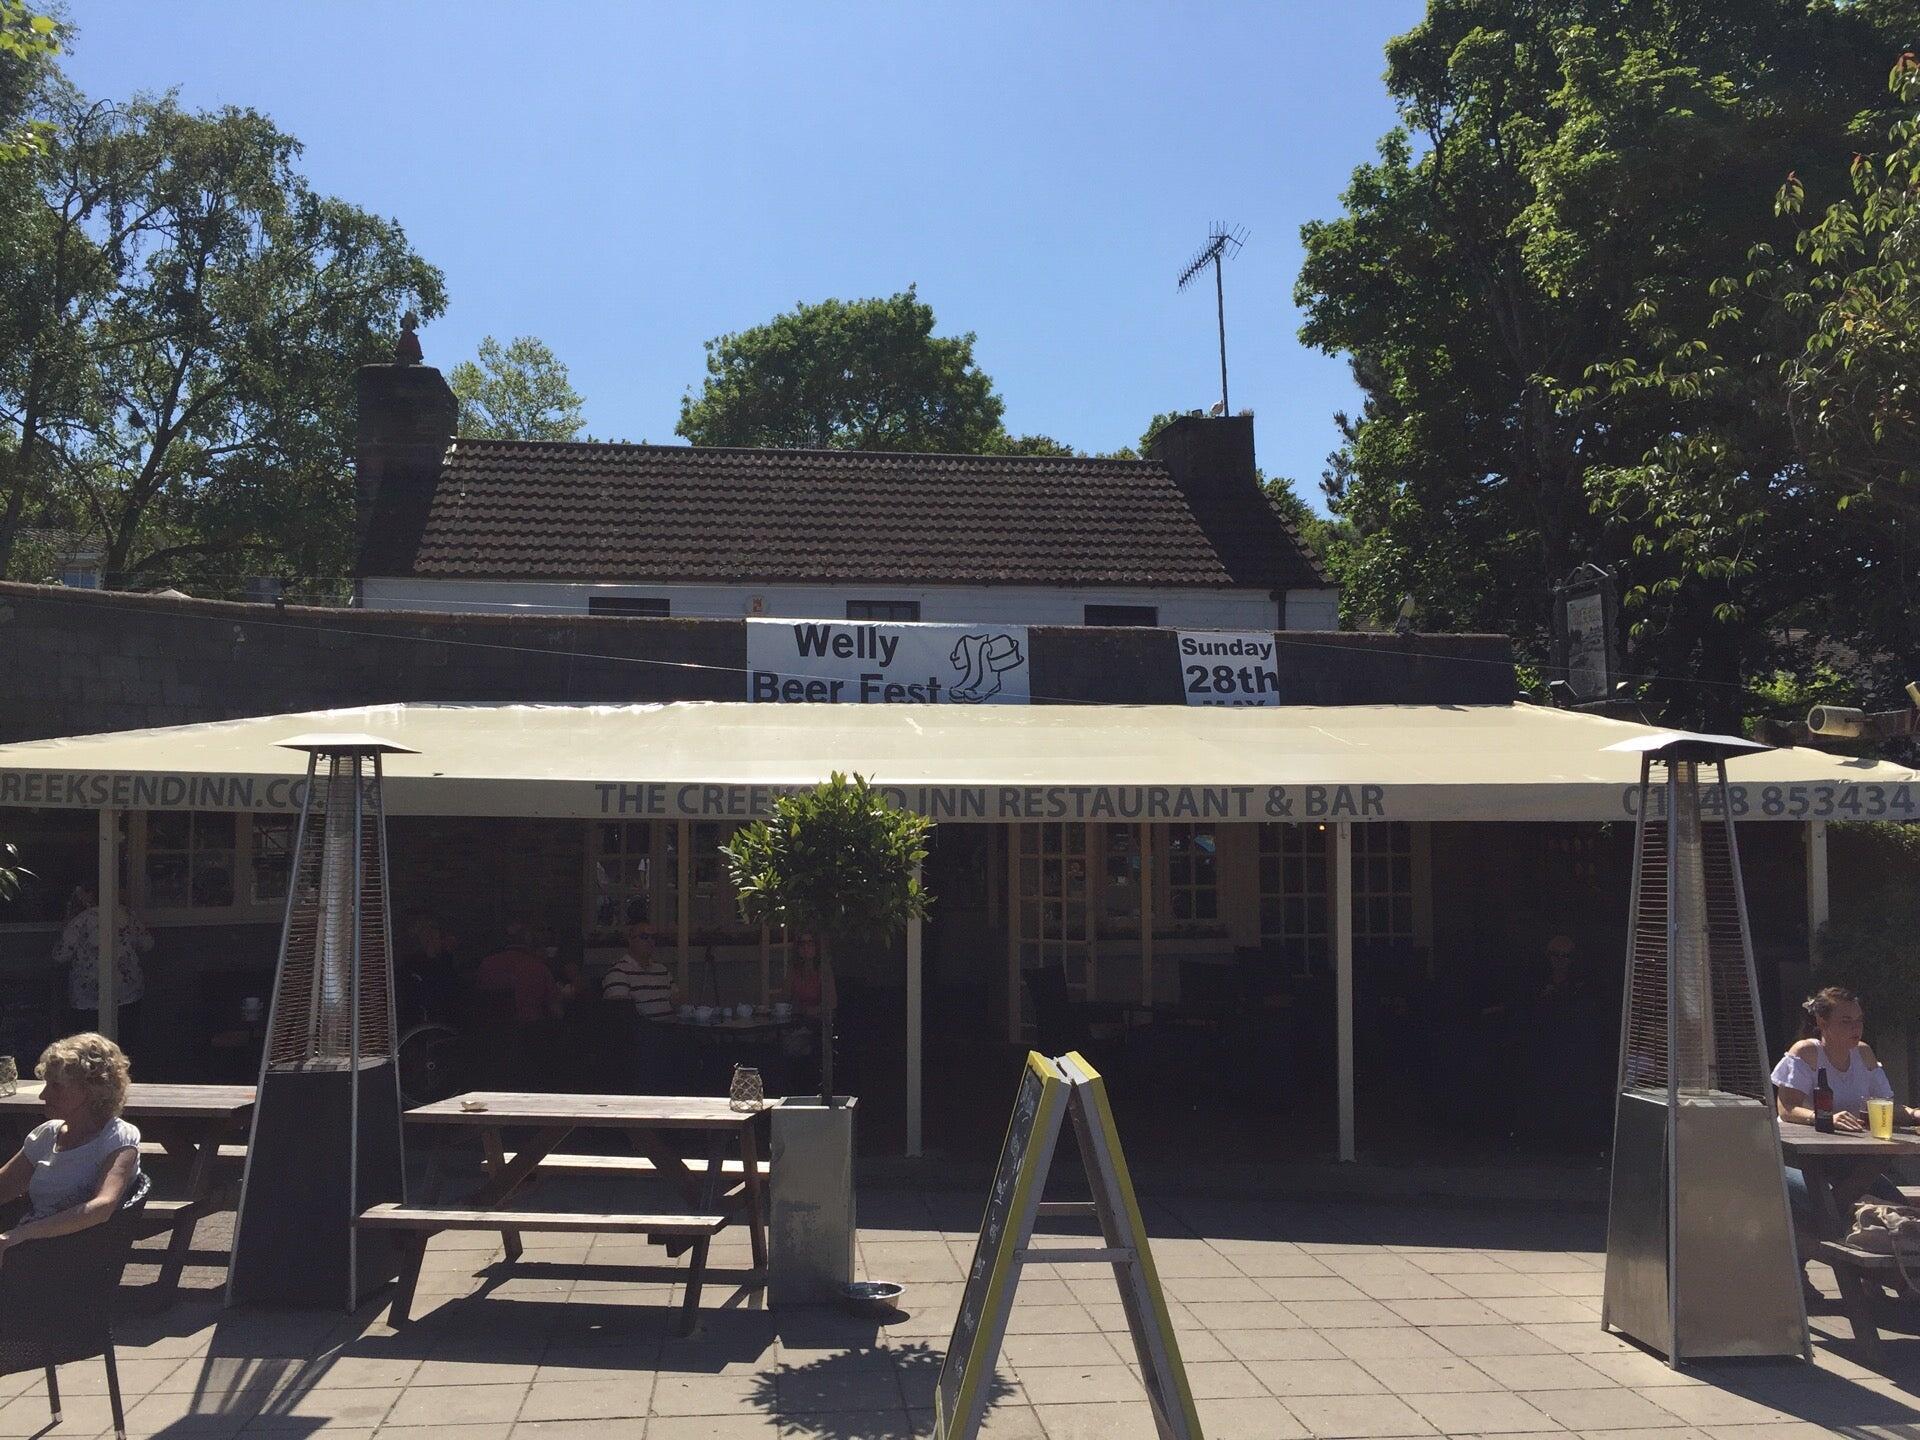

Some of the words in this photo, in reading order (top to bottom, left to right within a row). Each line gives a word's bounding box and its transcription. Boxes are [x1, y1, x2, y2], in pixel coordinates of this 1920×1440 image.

[794, 624, 899, 667] Welly
[1182, 638, 1272, 660] Sunday
[753, 671, 844, 703] Beer
[860, 673, 941, 703] Fest
[1186, 665, 1280, 693] 28th
[595, 784, 666, 814] THE
[919, 787, 986, 817] INN
[1000, 786, 1254, 817] RESTAURANT
[1265, 784, 1293, 816] &
[1305, 784, 1385, 816] BAR
[1622, 785, 1749, 816] 0148
[1761, 784, 1915, 816] 853434
